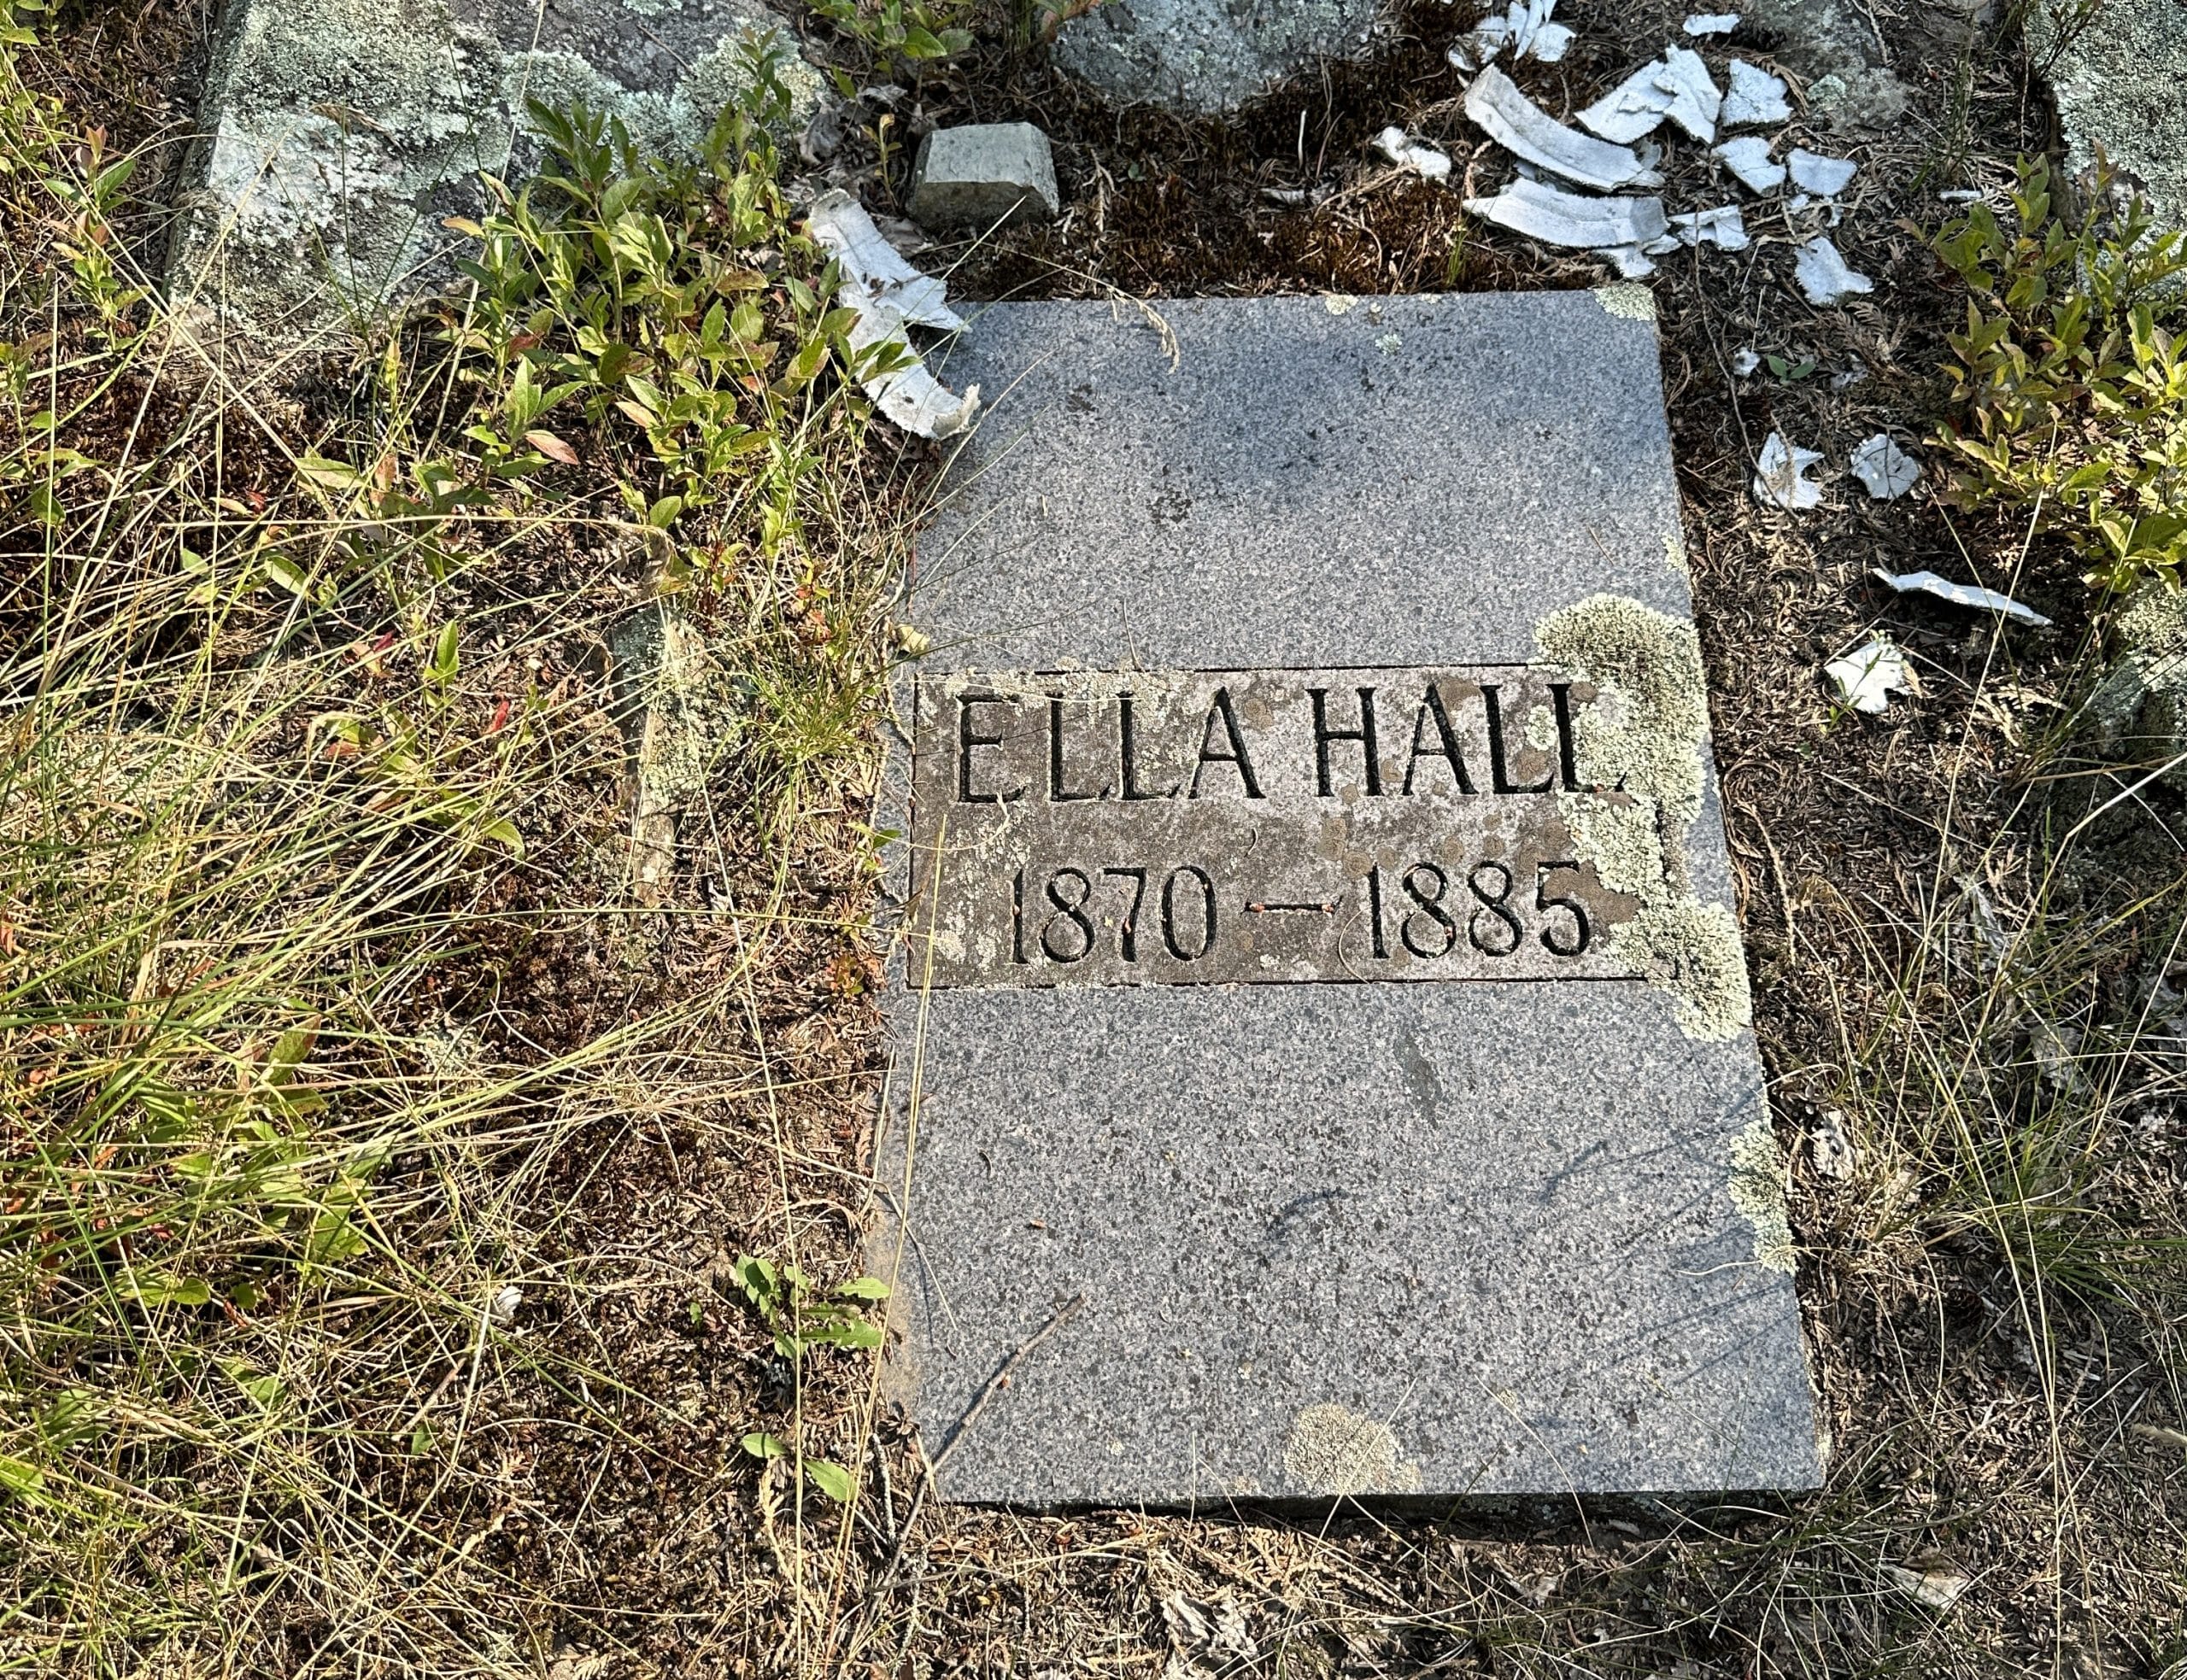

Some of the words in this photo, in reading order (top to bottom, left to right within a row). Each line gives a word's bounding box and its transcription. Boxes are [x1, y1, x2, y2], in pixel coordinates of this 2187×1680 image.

[958, 686, 1266, 803] ELLA
[1305, 682, 1627, 796] HALL
[1011, 864, 1217, 964] 1870
[1367, 859, 1591, 961] 1885
